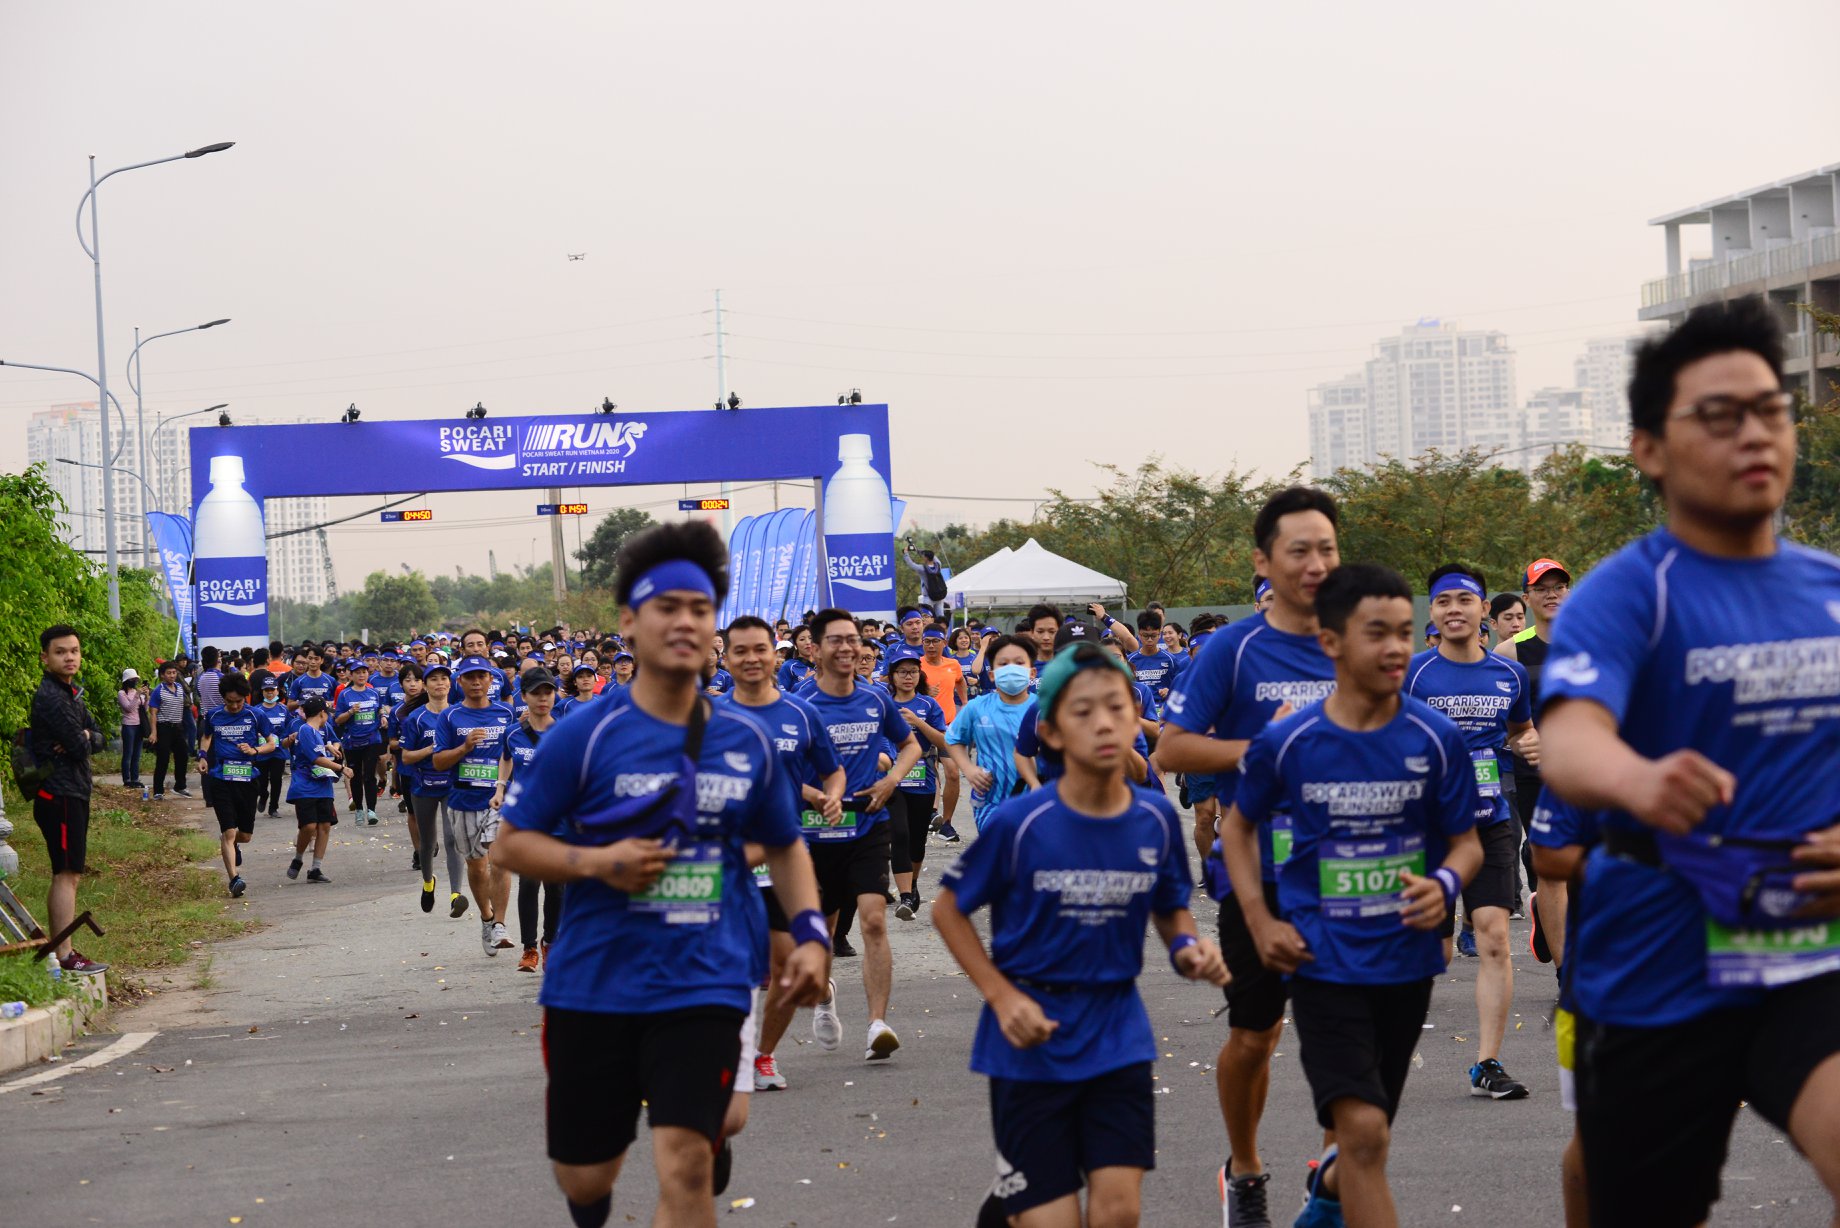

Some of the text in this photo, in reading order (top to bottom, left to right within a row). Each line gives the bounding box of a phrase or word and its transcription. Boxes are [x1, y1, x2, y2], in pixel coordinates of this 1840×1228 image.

[440, 425, 512, 439] POCARI
[440, 438, 506, 452] SWEAT
[522, 462, 568, 477] START
[578, 460, 626, 475] FINISH
[829, 555, 888, 567] POCARI
[829, 565, 883, 577] SWEAT
[200, 579, 260, 591] POCARI
[200, 590, 256, 601] SWEAT
[227, 767, 248, 775] 50531
[464, 769, 492, 778] 50151
